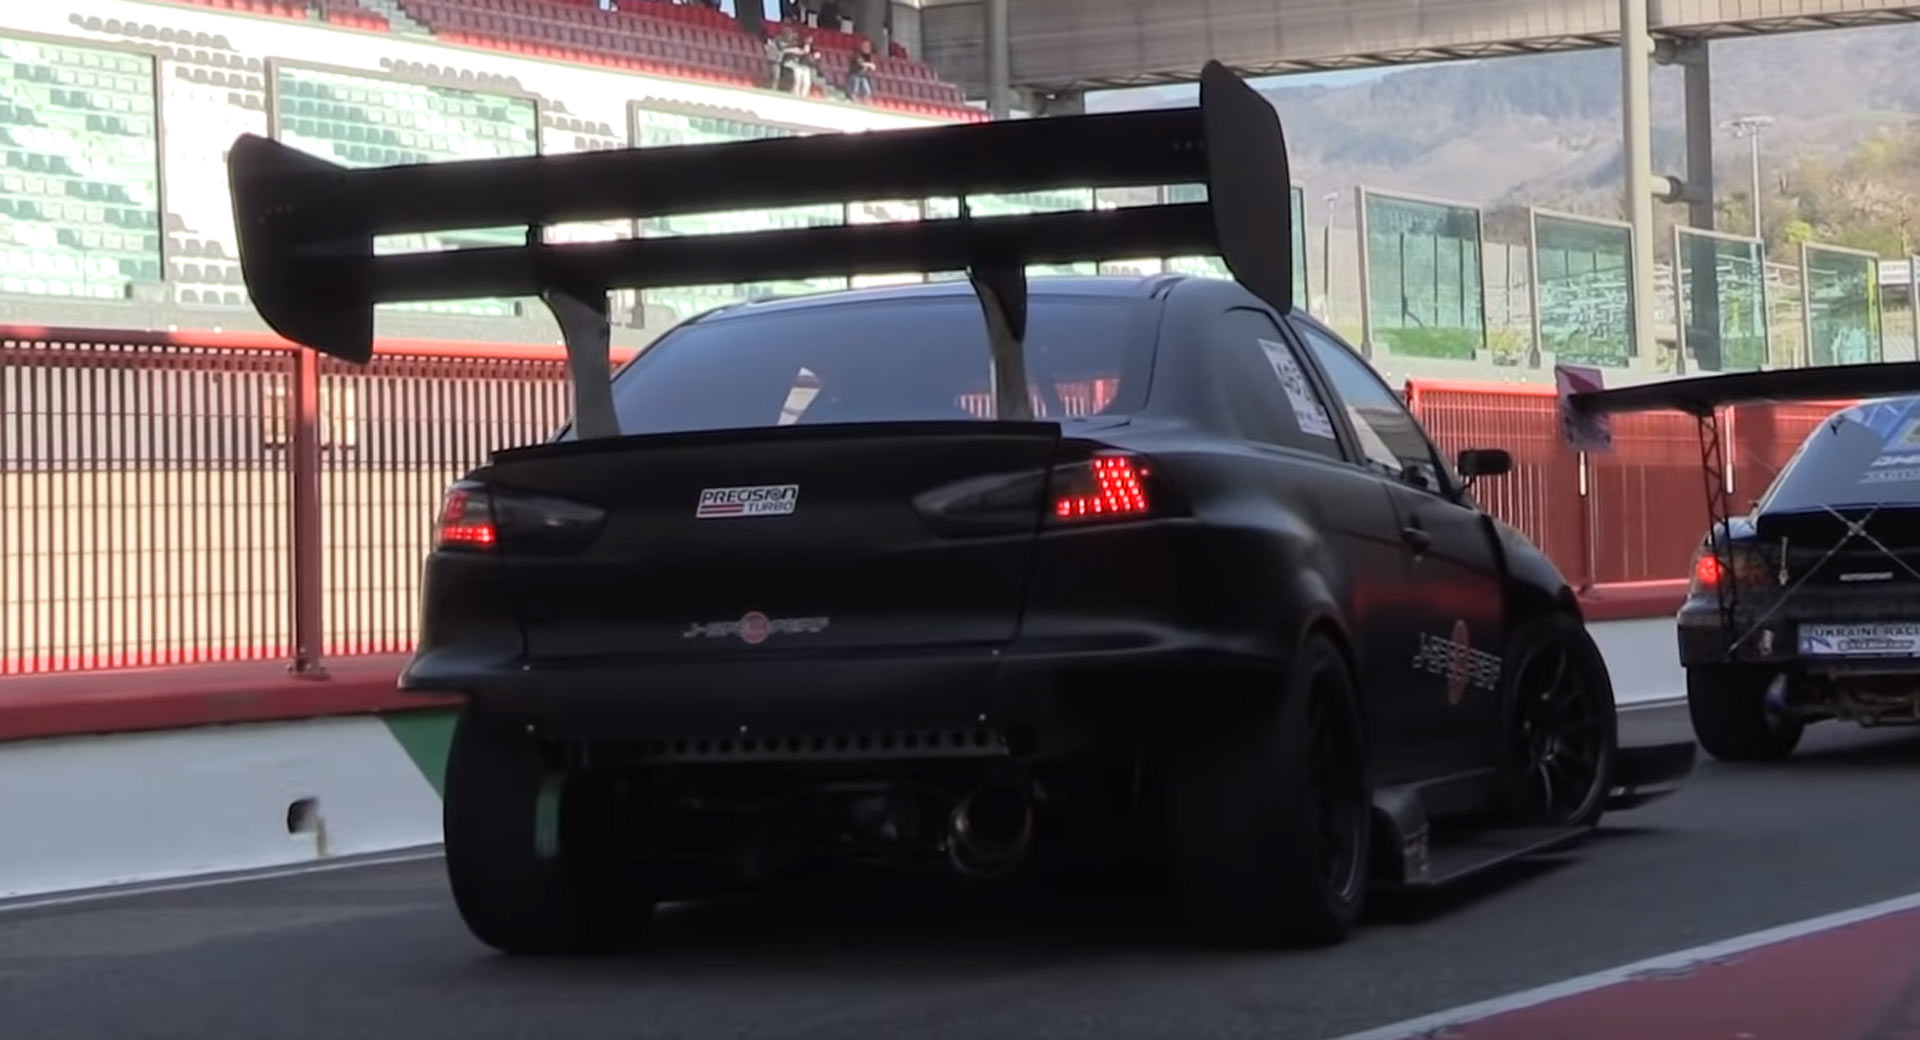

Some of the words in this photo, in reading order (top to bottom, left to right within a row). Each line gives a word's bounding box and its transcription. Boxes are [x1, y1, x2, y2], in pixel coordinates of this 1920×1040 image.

[701, 487, 797, 503] PRECISION
[747, 501, 794, 512] TURBO
[1814, 626, 1878, 638] UKRAINE
